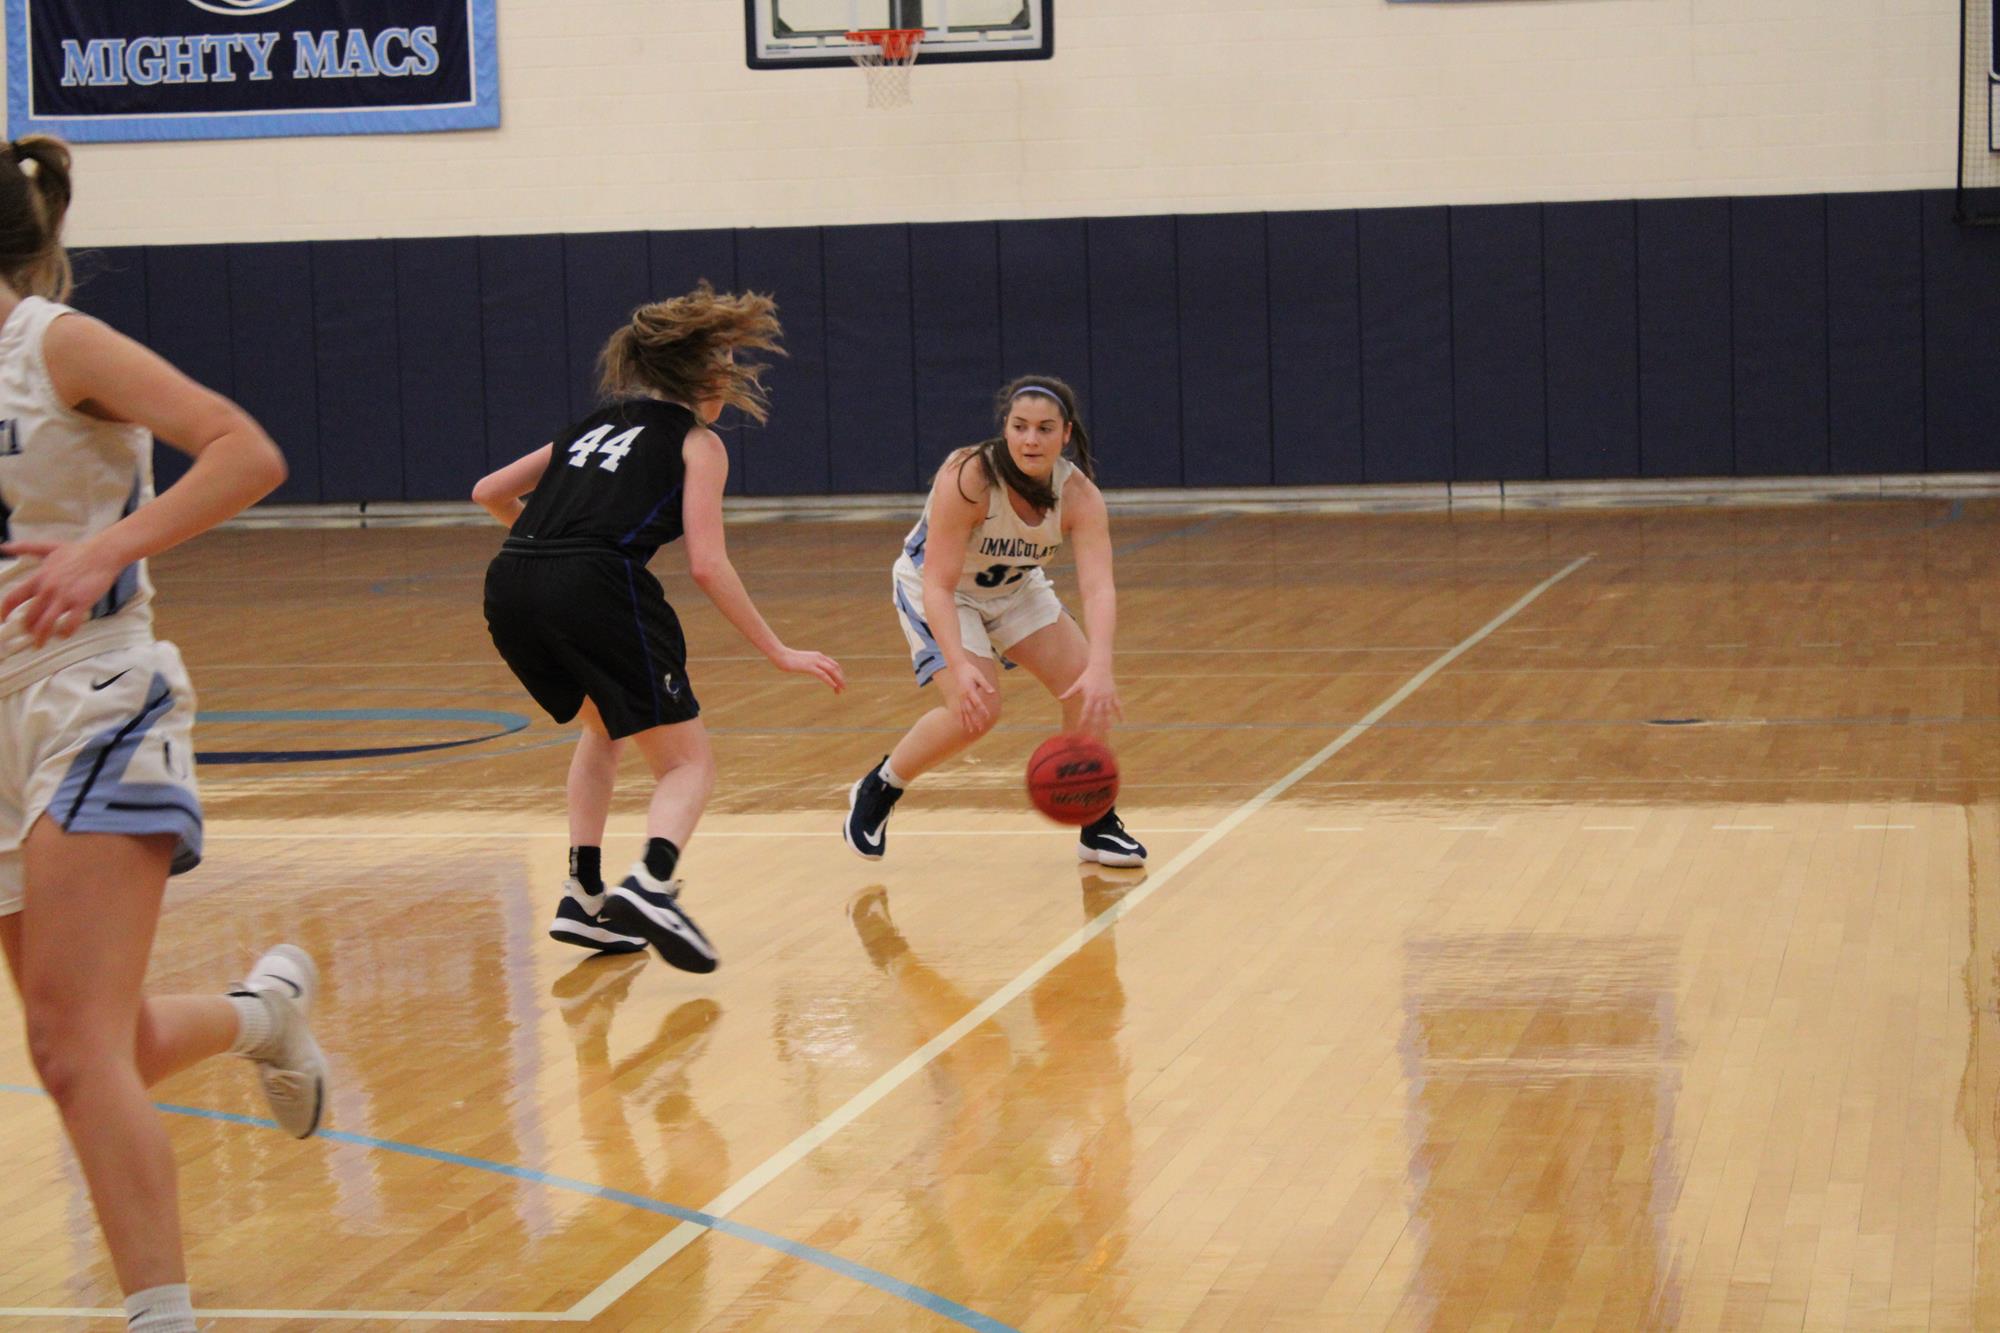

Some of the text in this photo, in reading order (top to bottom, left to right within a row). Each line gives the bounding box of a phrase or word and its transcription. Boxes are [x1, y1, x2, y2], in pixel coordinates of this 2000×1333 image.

[61, 26, 439, 86] MIGHTY MACS
[568, 423, 645, 473] 44
